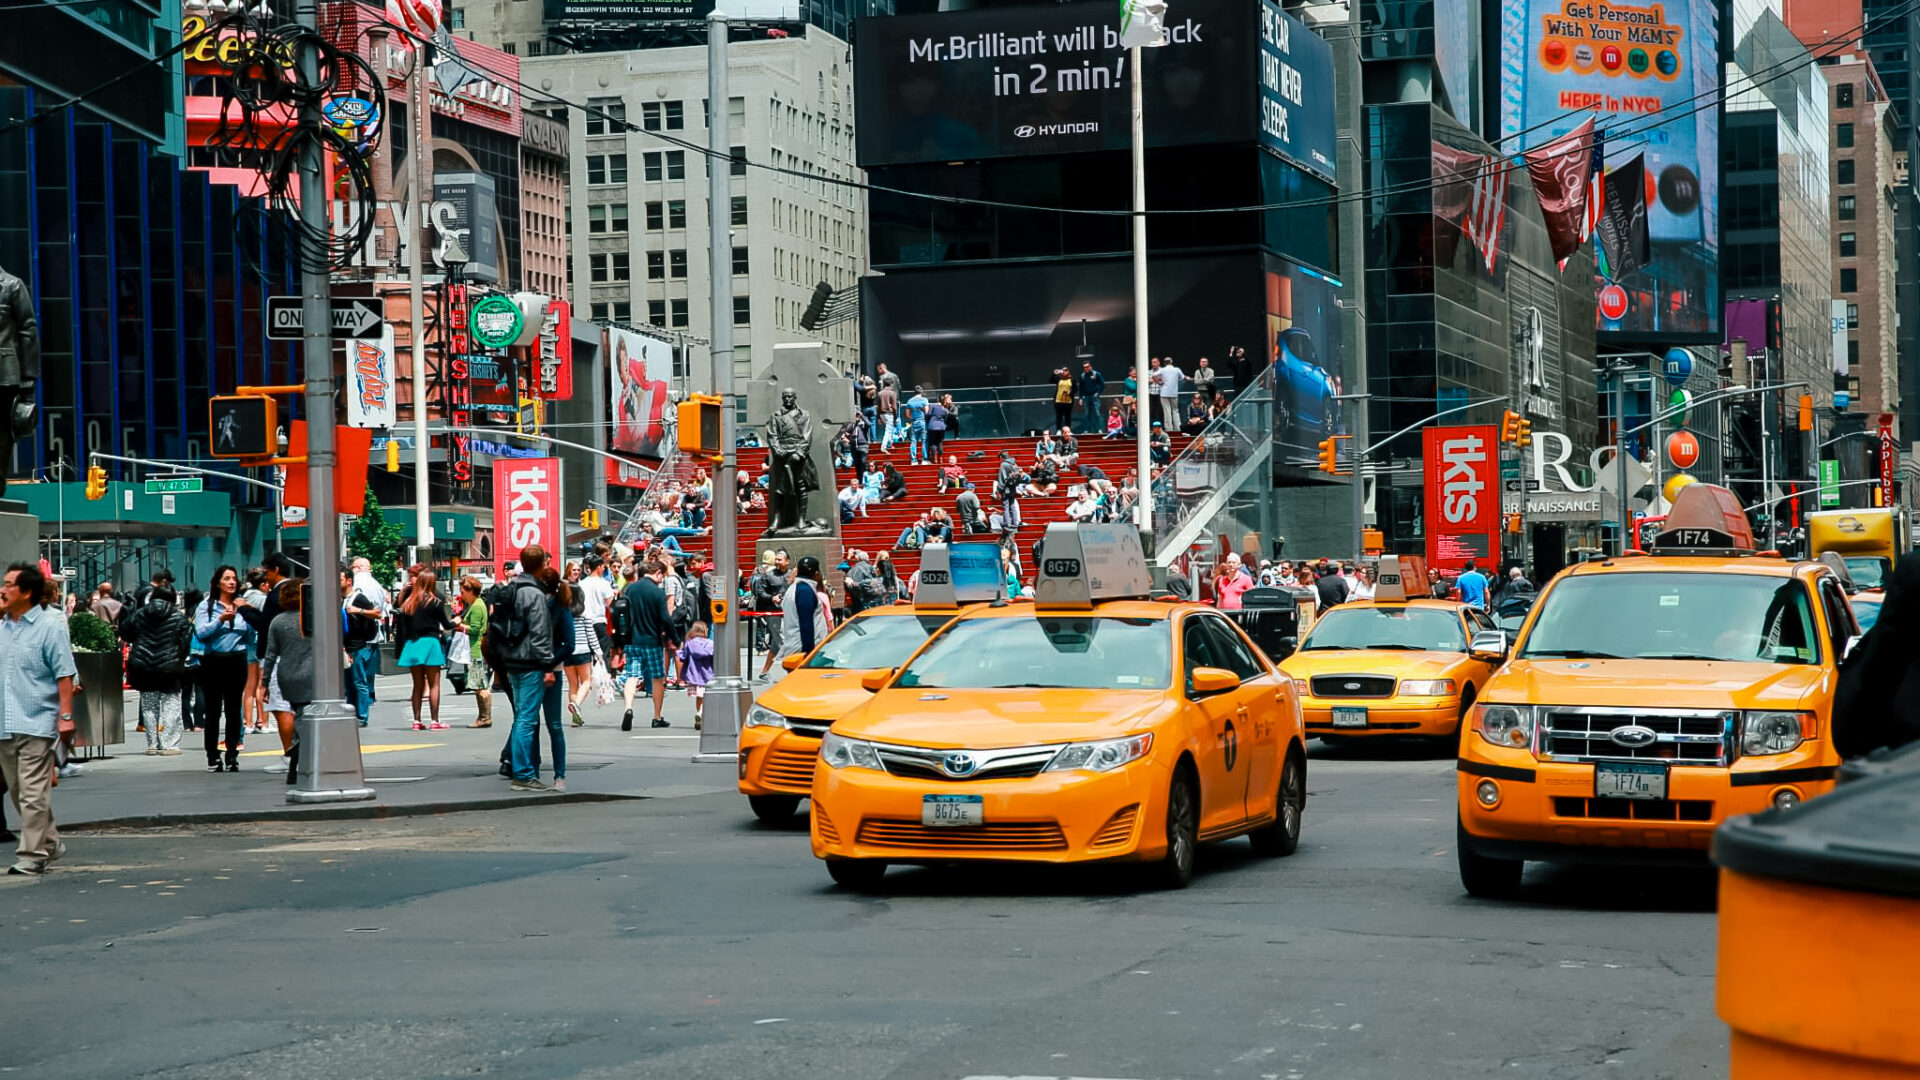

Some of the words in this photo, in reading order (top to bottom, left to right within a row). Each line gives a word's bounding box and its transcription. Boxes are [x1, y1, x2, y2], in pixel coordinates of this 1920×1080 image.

[1566, 2, 1594, 19] Get
[1599, 5, 1660, 25] Personal
[1275, 13, 1290, 56] CAR
[1547, 20, 1584, 38] With
[1589, 24, 1622, 41] Your
[909, 29, 1047, 62] Mr.Brilliant
[1054, 25, 1095, 52] will
[994, 67, 1020, 97] in
[1030, 64, 1048, 94] 2
[1057, 57, 1125, 92] min!
[1261, 48, 1279, 93] THAT
[1280, 61, 1303, 107] NEVER
[1560, 91, 1602, 109] HERE
[1039, 122, 1099, 136] HYUNDAI
[1603, 215, 1620, 250] HOTELS
[1604, 181, 1635, 270] RENAISSANCE
[331, 311, 367, 327] WAY
[540, 309, 561, 392] Twizzlers
[1681, 443, 1694, 456] m
[169, 482, 178, 490] 47
[1443, 434, 1487, 524] tkts
[510, 466, 548, 549] tkts
[1510, 500, 1600, 514] RNAISSANCE
[1676, 530, 1710, 545] 1F74
[1048, 559, 1078, 573] 8G75
